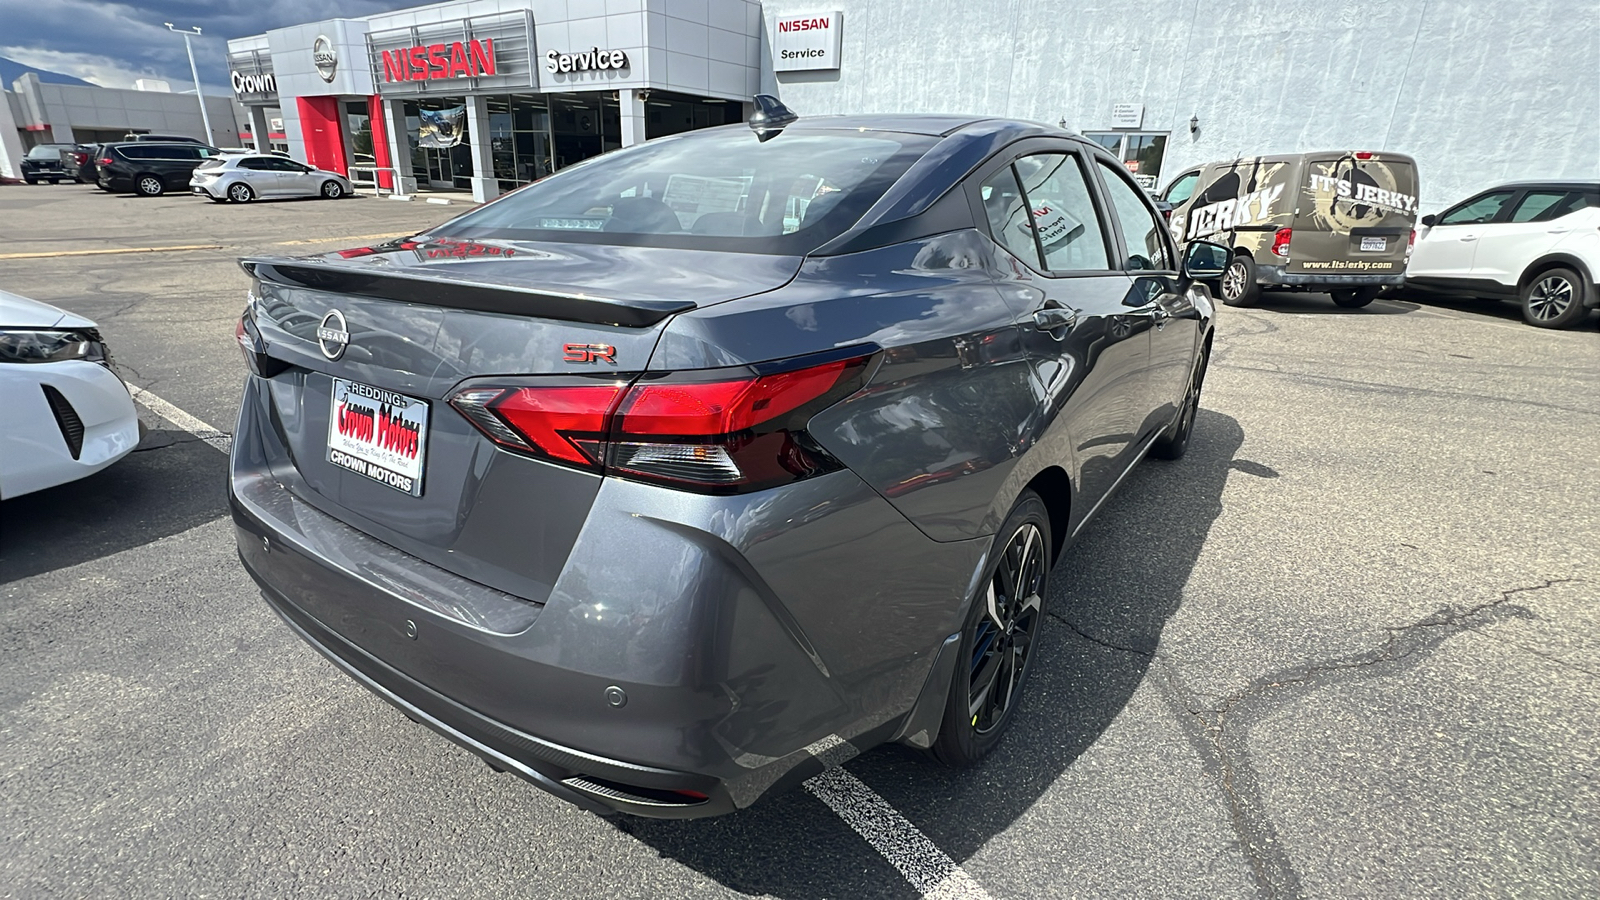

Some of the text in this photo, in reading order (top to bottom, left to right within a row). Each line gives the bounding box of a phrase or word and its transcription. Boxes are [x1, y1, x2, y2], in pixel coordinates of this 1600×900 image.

[779, 17, 829, 33] NISSAN
[381, 38, 496, 83] NISSAN
[546, 46, 625, 74] Service
[781, 48, 825, 59] Service
[231, 70, 275, 94] Crown
[1186, 182, 1286, 240] JERKY
[1310, 173, 1351, 197] IT'S
[1355, 183, 1415, 212] JERKY
[563, 343, 616, 364] SR
[338, 400, 374, 444] Crown
[377, 408, 418, 460] Motors
[331, 450, 412, 492] CROWN MOTORS
